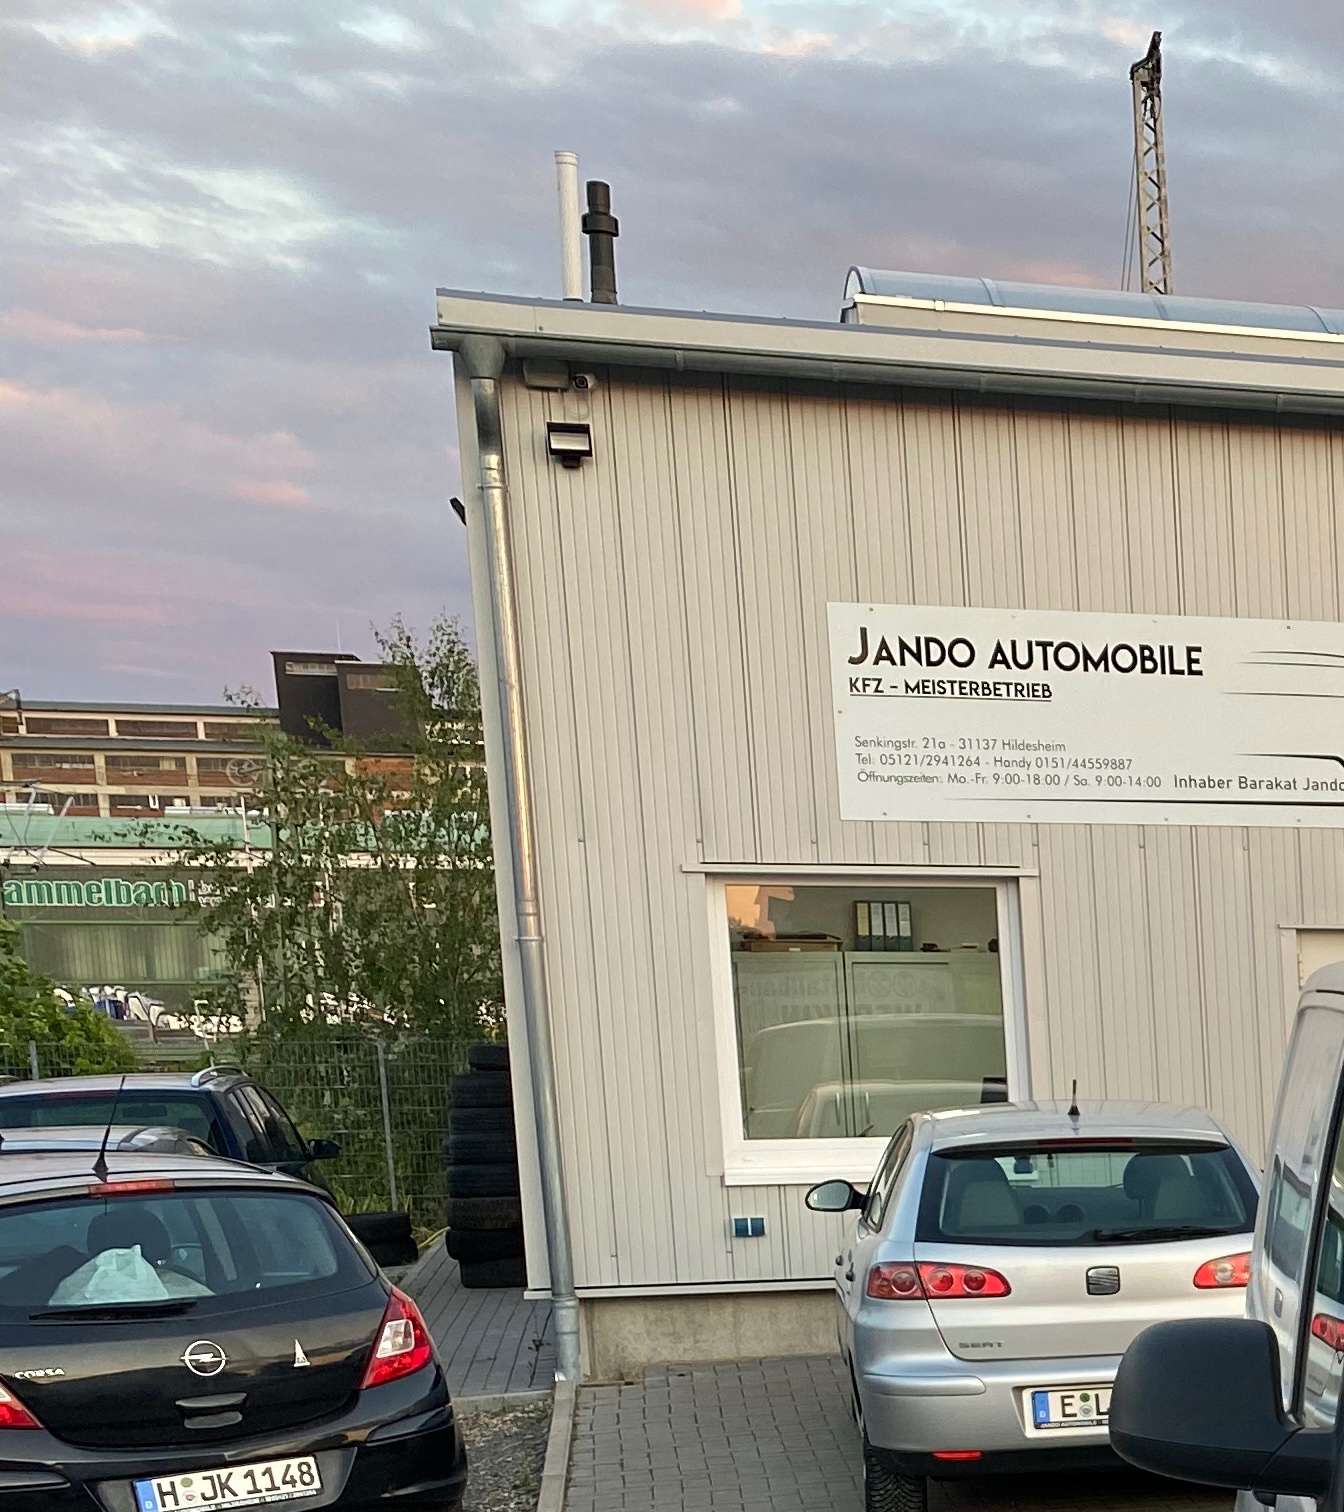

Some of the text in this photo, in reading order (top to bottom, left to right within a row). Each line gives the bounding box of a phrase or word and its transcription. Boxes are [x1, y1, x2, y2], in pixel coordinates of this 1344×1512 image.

[848, 626, 1204, 677] JANDO AUTOMOBILE
[849, 677, 885, 694] KFZ
[904, 679, 1053, 699] MEISTERBETRIEB
[854, 735, 918, 751] Senkingstr.
[922, 736, 946, 750] 21a
[958, 737, 997, 751] 31137
[1002, 738, 1067, 752] Hildesheim
[879, 753, 981, 768] 05121/2941264
[993, 756, 1032, 770] Handy
[1035, 756, 1133, 771] 0151/44559887
[857, 768, 944, 786] Öffnungszeiten:
[992, 772, 1061, 787] 9:00-18:00
[1095, 775, 1162, 788] 9:00-14:00
[1173, 774, 1233, 790] Inhaber
[1238, 775, 1298, 791] Barakat
[1060, 1394, 1078, 1418] E
[156, 1480, 180, 1508] H
[200, 1471, 240, 1502] JK
[243, 1460, 316, 1496] 1148
